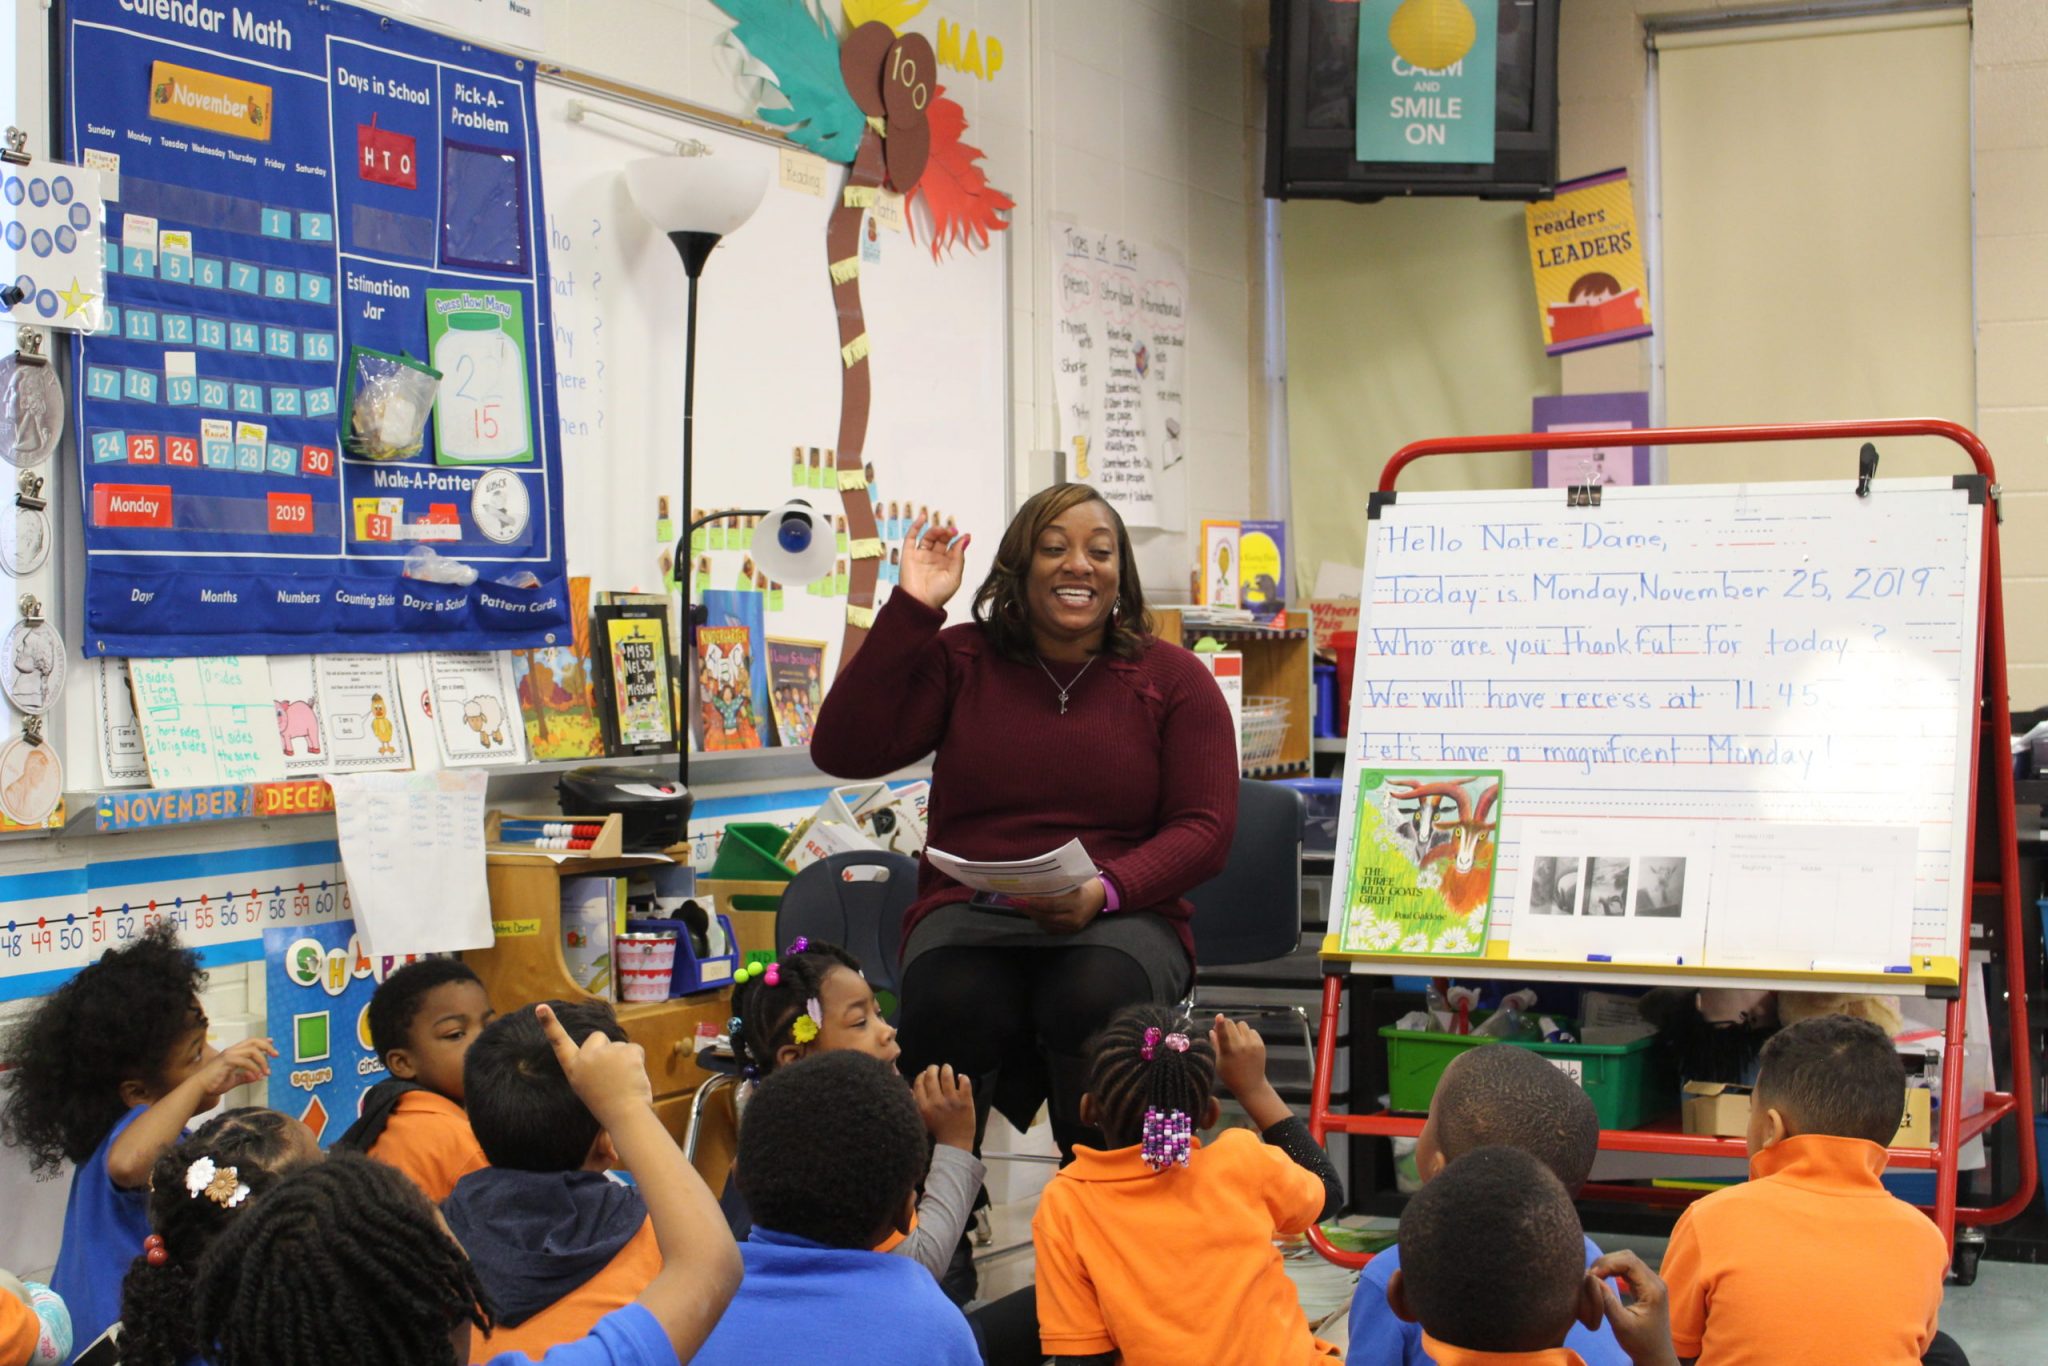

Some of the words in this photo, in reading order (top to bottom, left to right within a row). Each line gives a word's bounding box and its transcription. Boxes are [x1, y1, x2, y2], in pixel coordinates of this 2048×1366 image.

[509, 1, 531, 17] Nurse
[232, 7, 292, 50] Math
[937, 17, 1004, 81] MAP
[337, 68, 369, 93] Days
[372, 77, 384, 96] in
[388, 80, 430, 105] School
[892, 47, 927, 109] 100
[1413, 81, 1441, 92] AND
[172, 83, 248, 118] November
[455, 83, 504, 108] Pick-A-
[1390, 96, 1462, 118] SMILE
[451, 107, 509, 134] Problem
[1405, 123, 1445, 144] ON
[87, 123, 116, 138] Sunday
[127, 129, 152, 144] Monday
[160, 136, 188, 152] Tuesday
[191, 142, 226, 160] Wednesday
[227, 150, 257, 165] Thursday
[264, 157, 286, 171] Friday
[295, 163, 327, 177] Saturday
[364, 146, 374, 167] H
[382, 151, 391, 170] T
[400, 155, 411, 174] O
[272, 214, 279, 234] 1
[311, 217, 321, 237] 2
[1533, 209, 1606, 237] readers
[1537, 230, 1632, 268] LEADERS
[133, 252, 144, 272] 4
[170, 258, 180, 277] 5
[204, 263, 213, 284] 6
[238, 267, 249, 287] 7
[275, 274, 285, 294] 8
[309, 278, 320, 297] 9
[347, 272, 410, 299] Estimation
[363, 301, 385, 320] Jar
[435, 297, 461, 314] Guess
[463, 293, 482, 308] How
[485, 296, 512, 318] Many
[131, 315, 149, 336] 11
[168, 319, 187, 339] 12
[201, 323, 220, 345] 13
[235, 326, 253, 347] 14
[271, 332, 290, 354] 15
[308, 336, 328, 357] 16
[93, 373, 114, 395] 17
[130, 373, 151, 397] 18
[172, 379, 192, 400] 19
[204, 383, 224, 405] 20
[239, 389, 256, 410] 21
[276, 392, 295, 411] 22
[311, 391, 330, 412] 23
[474, 404, 501, 439] 15
[98, 435, 120, 457] 24
[133, 439, 154, 460] 25
[172, 441, 193, 462] 26
[212, 445, 229, 465] 27
[241, 447, 257, 467] 28
[271, 451, 291, 473] 29
[307, 452, 329, 472] 30
[110, 496, 159, 517] Monday
[276, 504, 306, 521] 2019
[371, 518, 388, 538] 31
[1388, 525, 1463, 553] Hello
[1482, 524, 1560, 550] Notre
[1582, 522, 1668, 551] Dame,
[131, 588, 155, 604] Days
[200, 589, 238, 603] Months
[277, 590, 321, 604] Numbers
[336, 590, 376, 608] Counting
[403, 594, 434, 611] Days
[435, 597, 444, 611] in
[481, 593, 526, 612] Pattern
[529, 597, 557, 612] Cards
[1376, 574, 1477, 614] Today
[1498, 588, 1518, 602] is
[1533, 573, 1637, 606] Monday,
[1640, 572, 1769, 601] November
[1783, 569, 1832, 602] 25,
[1310, 603, 1359, 617] When
[1373, 627, 1433, 657] Who
[1450, 638, 1492, 656] are
[1506, 638, 1547, 664] you
[1706, 624, 1742, 656] for
[1770, 628, 1848, 664] today
[145, 672, 175, 684] sides
[1367, 680, 1409, 708] We
[1423, 680, 1465, 708] will
[1487, 679, 1545, 708] have
[1561, 692, 1651, 709] recess
[1667, 684, 1705, 709] at
[227, 730, 253, 744] sides
[1360, 732, 1422, 762] Let's
[1440, 733, 1489, 762] have
[1506, 747, 1521, 762] a
[1542, 734, 1681, 775] magnificent
[114, 791, 237, 825] NOVEMBER
[1363, 877, 1395, 887] THREE
[1364, 867, 1385, 877] THE
[1359, 896, 1395, 905] GRUFF
[1360, 886, 1387, 895] BILLY
[1388, 887, 1424, 897] GOATS
[1, 933, 22, 957] 48
[31, 930, 52, 954] 49
[60, 927, 83, 950] 50
[92, 919, 107, 942] 51
[116, 917, 135, 939] 52
[170, 910, 188, 931] 54
[195, 907, 214, 930] 55
[220, 905, 239, 927] 56
[245, 901, 263, 923] 57
[269, 898, 287, 920] 58
[293, 895, 311, 916] 59
[315, 893, 334, 913] 60
[1394, 911, 1413, 919] Paul
[1413, 912, 1447, 921] Galdone
[291, 1068, 332, 1089] square
